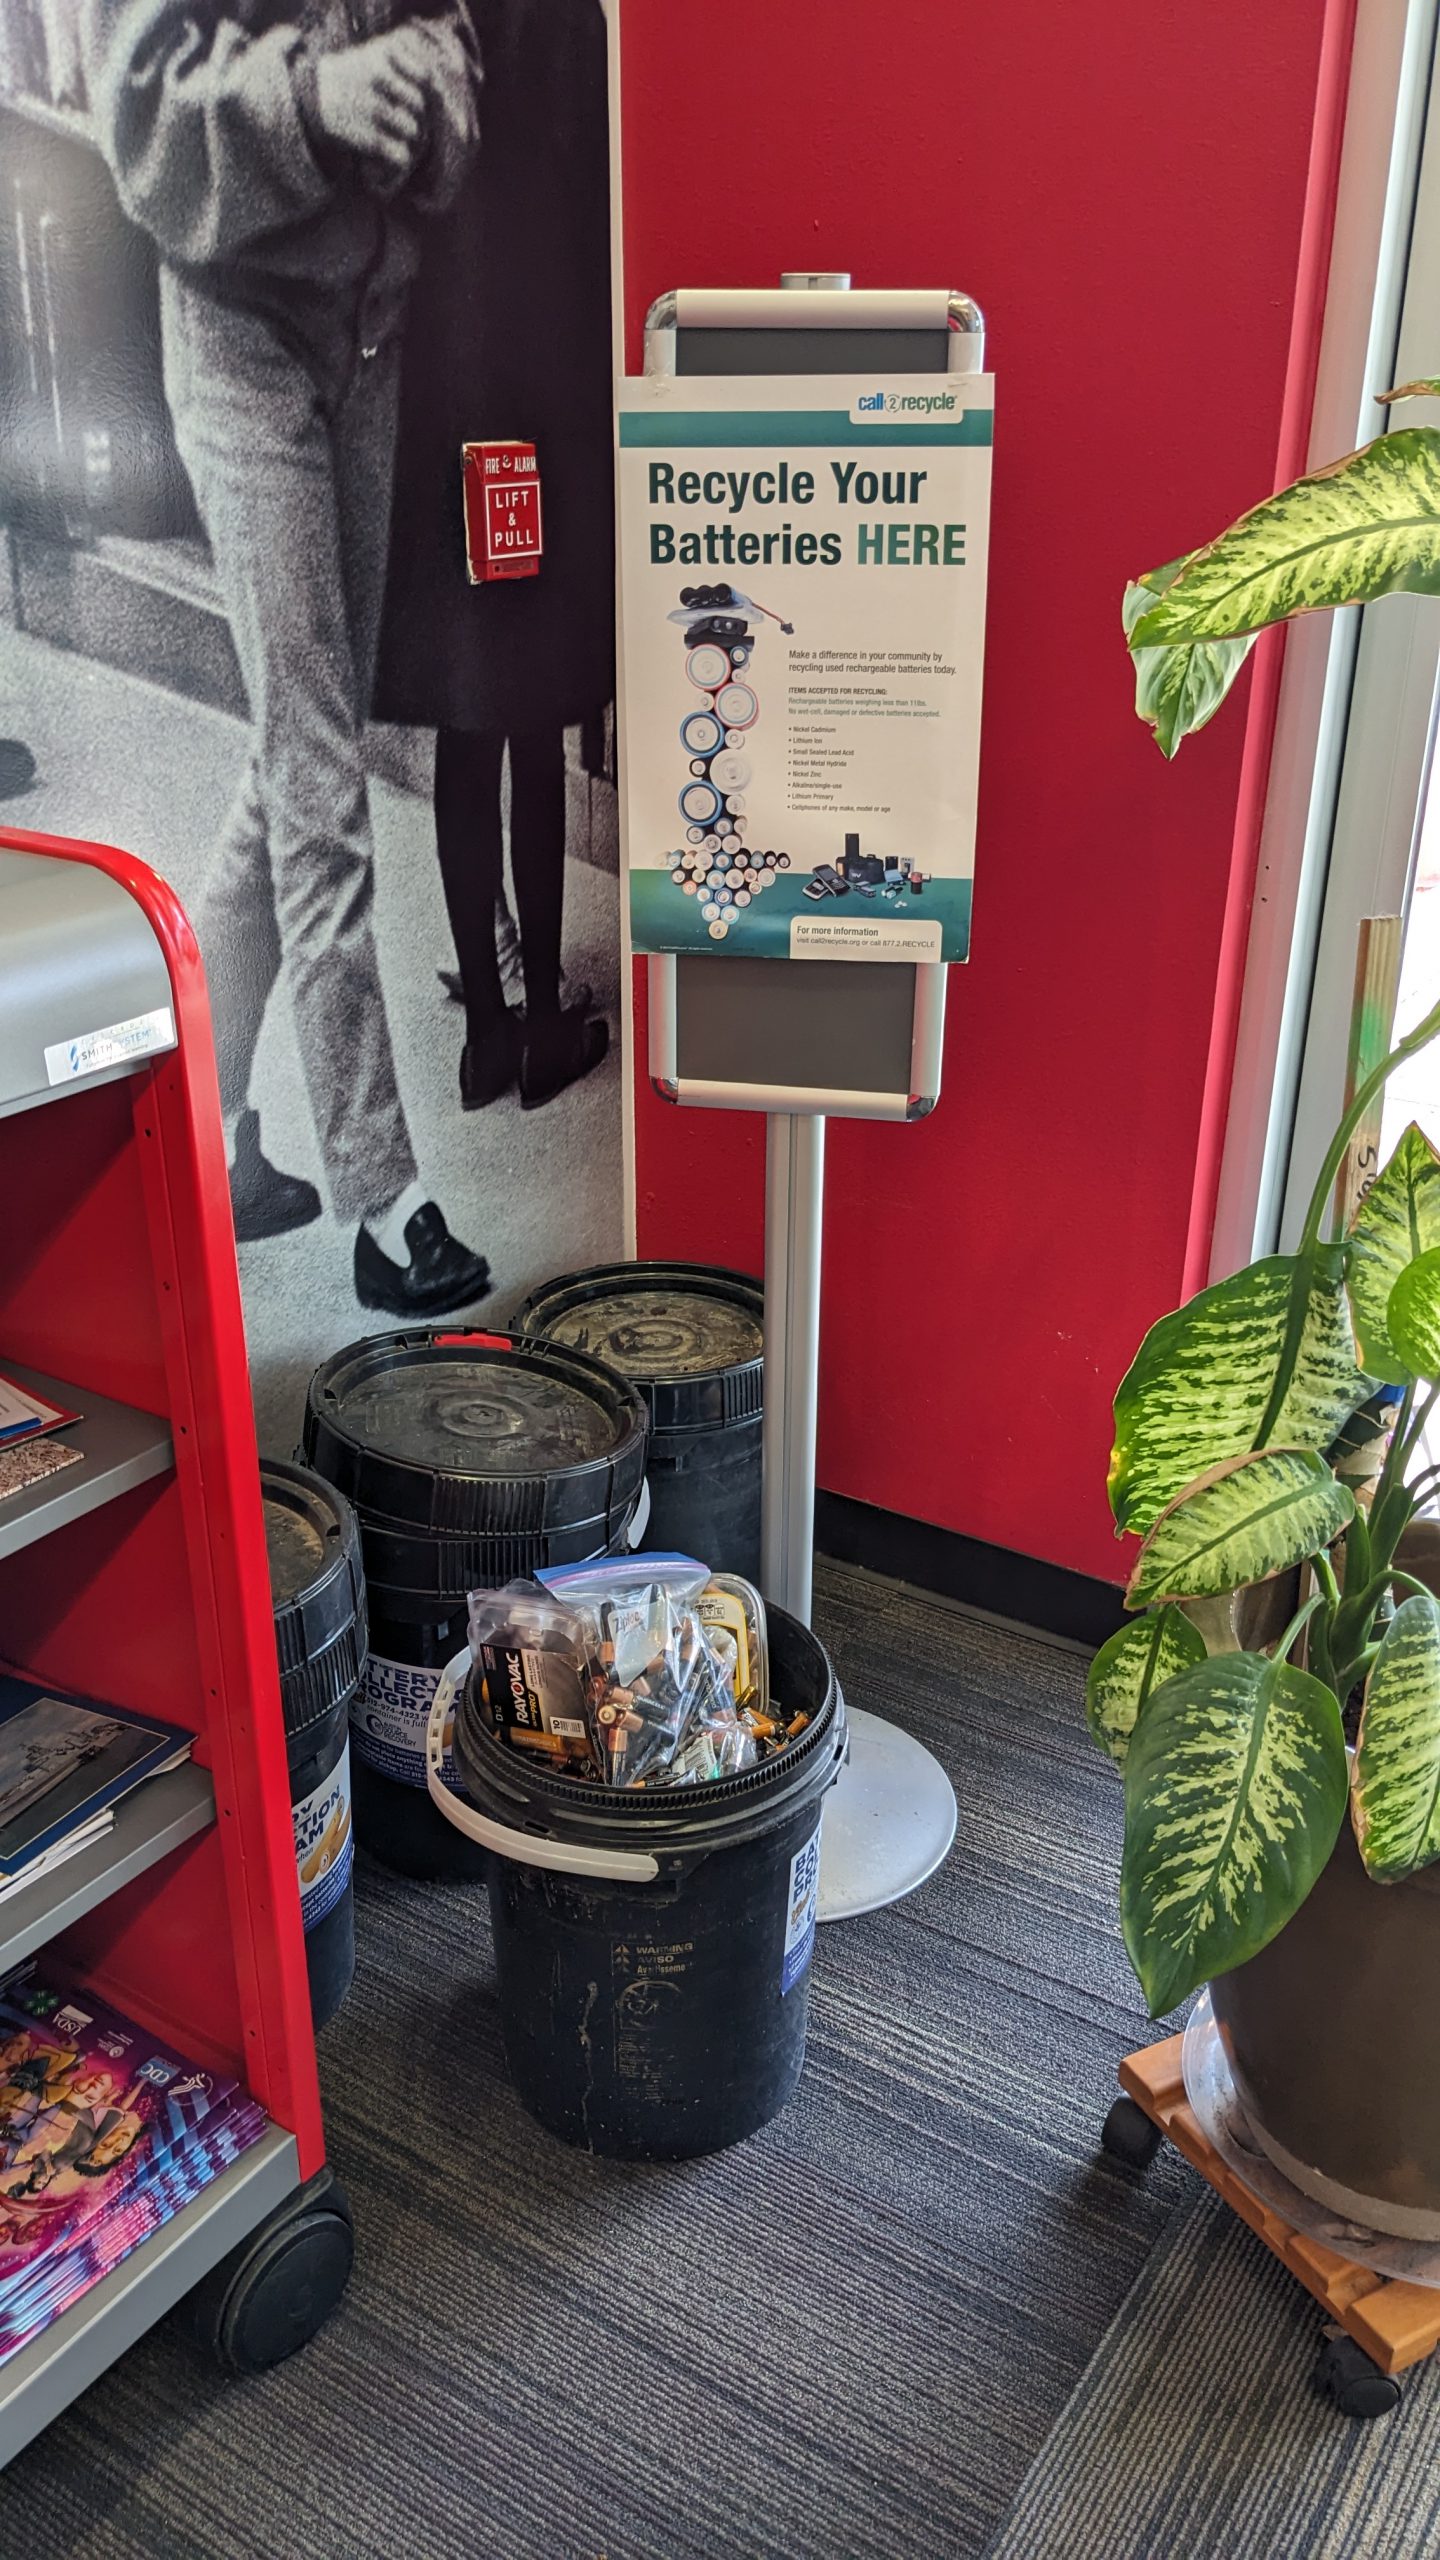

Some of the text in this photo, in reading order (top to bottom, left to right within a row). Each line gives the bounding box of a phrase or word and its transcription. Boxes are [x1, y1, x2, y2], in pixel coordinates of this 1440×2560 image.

[485, 456, 537, 475] FIRE ALARM
[648, 461, 927, 513] Recycle Your
[495, 491, 530, 509] LIFT
[508, 512, 517, 527] &
[495, 529, 534, 548] PULL
[649, 524, 966, 566] Batteries HERE
[789, 650, 942, 663] Make a difference in your community by
[789, 663, 957, 676] recycling used rechargeable batteries today.
[808, 687, 838, 695] ACCEPTED
[853, 688, 888, 696] RECYCLING:
[828, 698, 854, 706] batteries
[809, 748, 827, 756] Sealed
[797, 925, 879, 937] For more information
[797, 937, 810, 945] visit
[810, 938, 860, 947] call2recycle.org
[506, 1651, 530, 1725] RAYOVAC
[636, 1942, 694, 1956] WAING
[52, 2013, 82, 2036] USDA
[140, 2063, 170, 2084] CDC
